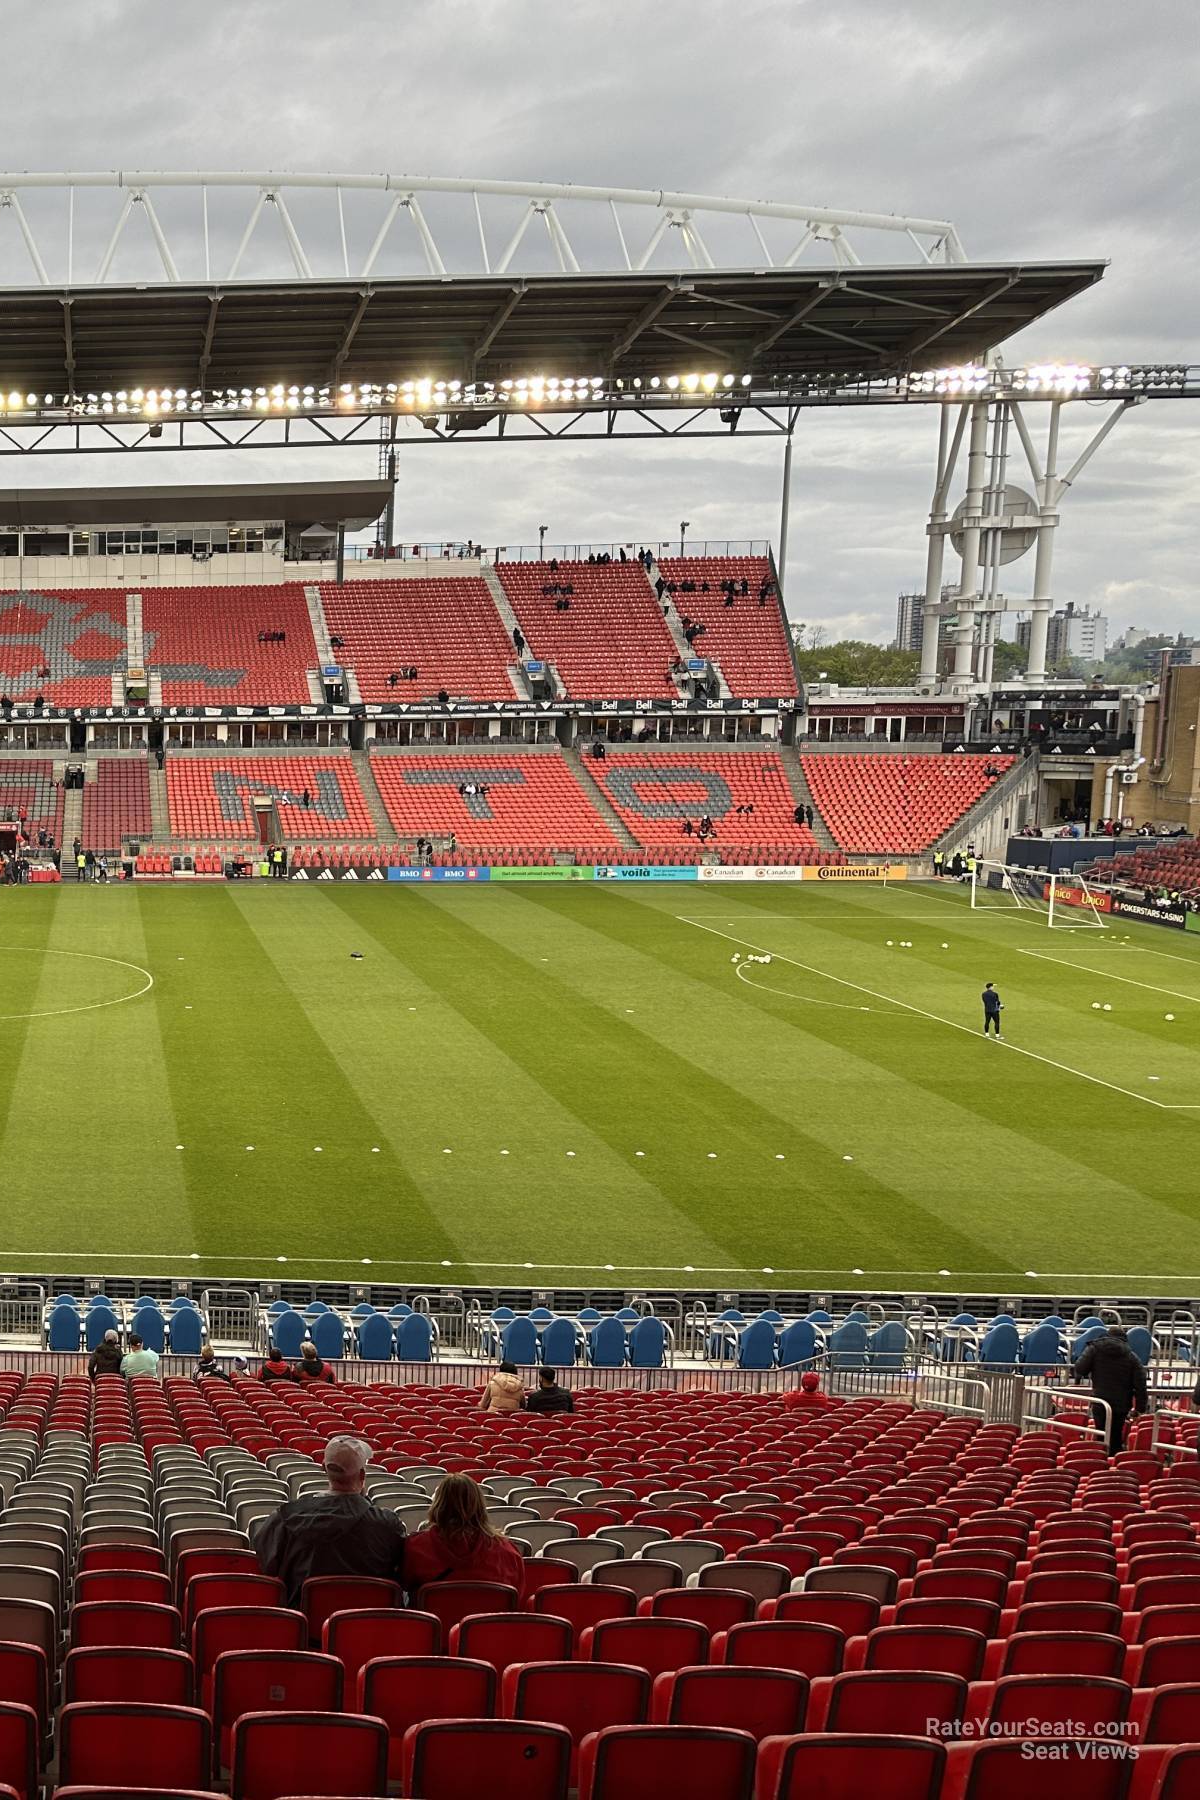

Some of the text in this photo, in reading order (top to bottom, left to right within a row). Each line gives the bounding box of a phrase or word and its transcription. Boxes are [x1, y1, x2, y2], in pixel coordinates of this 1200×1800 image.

[601, 701, 618, 710] Bell
[635, 700, 652, 710] Bell
[671, 699, 688, 709] Bell
[706, 699, 723, 709] Bell
[741, 698, 759, 709] Bell
[778, 698, 794, 708] Bell
[621, 868, 650, 877] voilà
[817, 867, 879, 879] Continental
[1120, 903, 1160, 918] POKERSTARS
